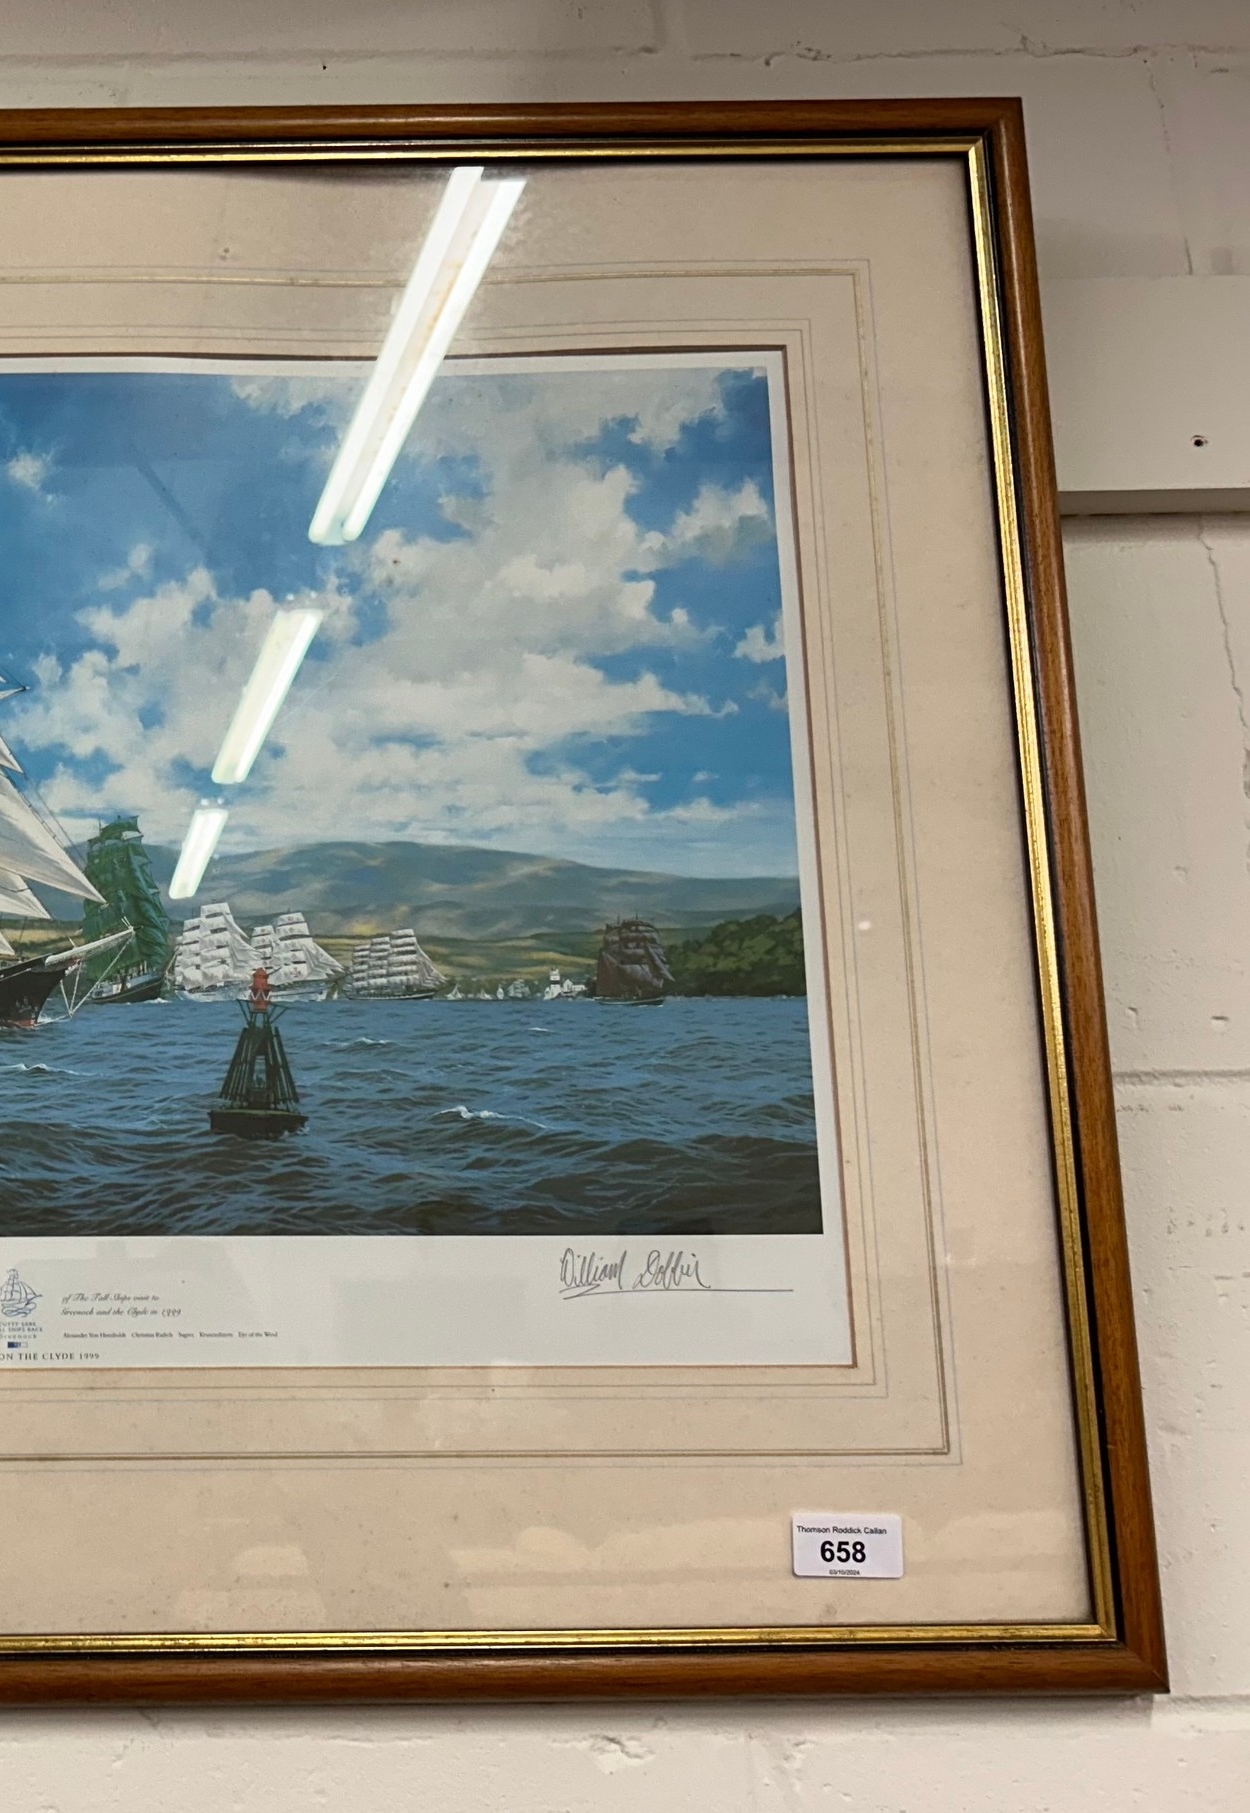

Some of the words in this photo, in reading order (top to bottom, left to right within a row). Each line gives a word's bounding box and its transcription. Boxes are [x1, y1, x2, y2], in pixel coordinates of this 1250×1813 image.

[61, 1293, 72, 1304] of
[96, 1306, 112, 1316] and
[112, 1306, 125, 1316] the
[18, 1352, 38, 1361] THE
[42, 1352, 75, 1360] CLYDE
[79, 1352, 100, 1360] 1999
[796, 1525, 831, 1534] Thomson
[832, 1526, 862, 1534] Roddick
[864, 1526, 887, 1535] Callan
[820, 1540, 866, 1563] 658
